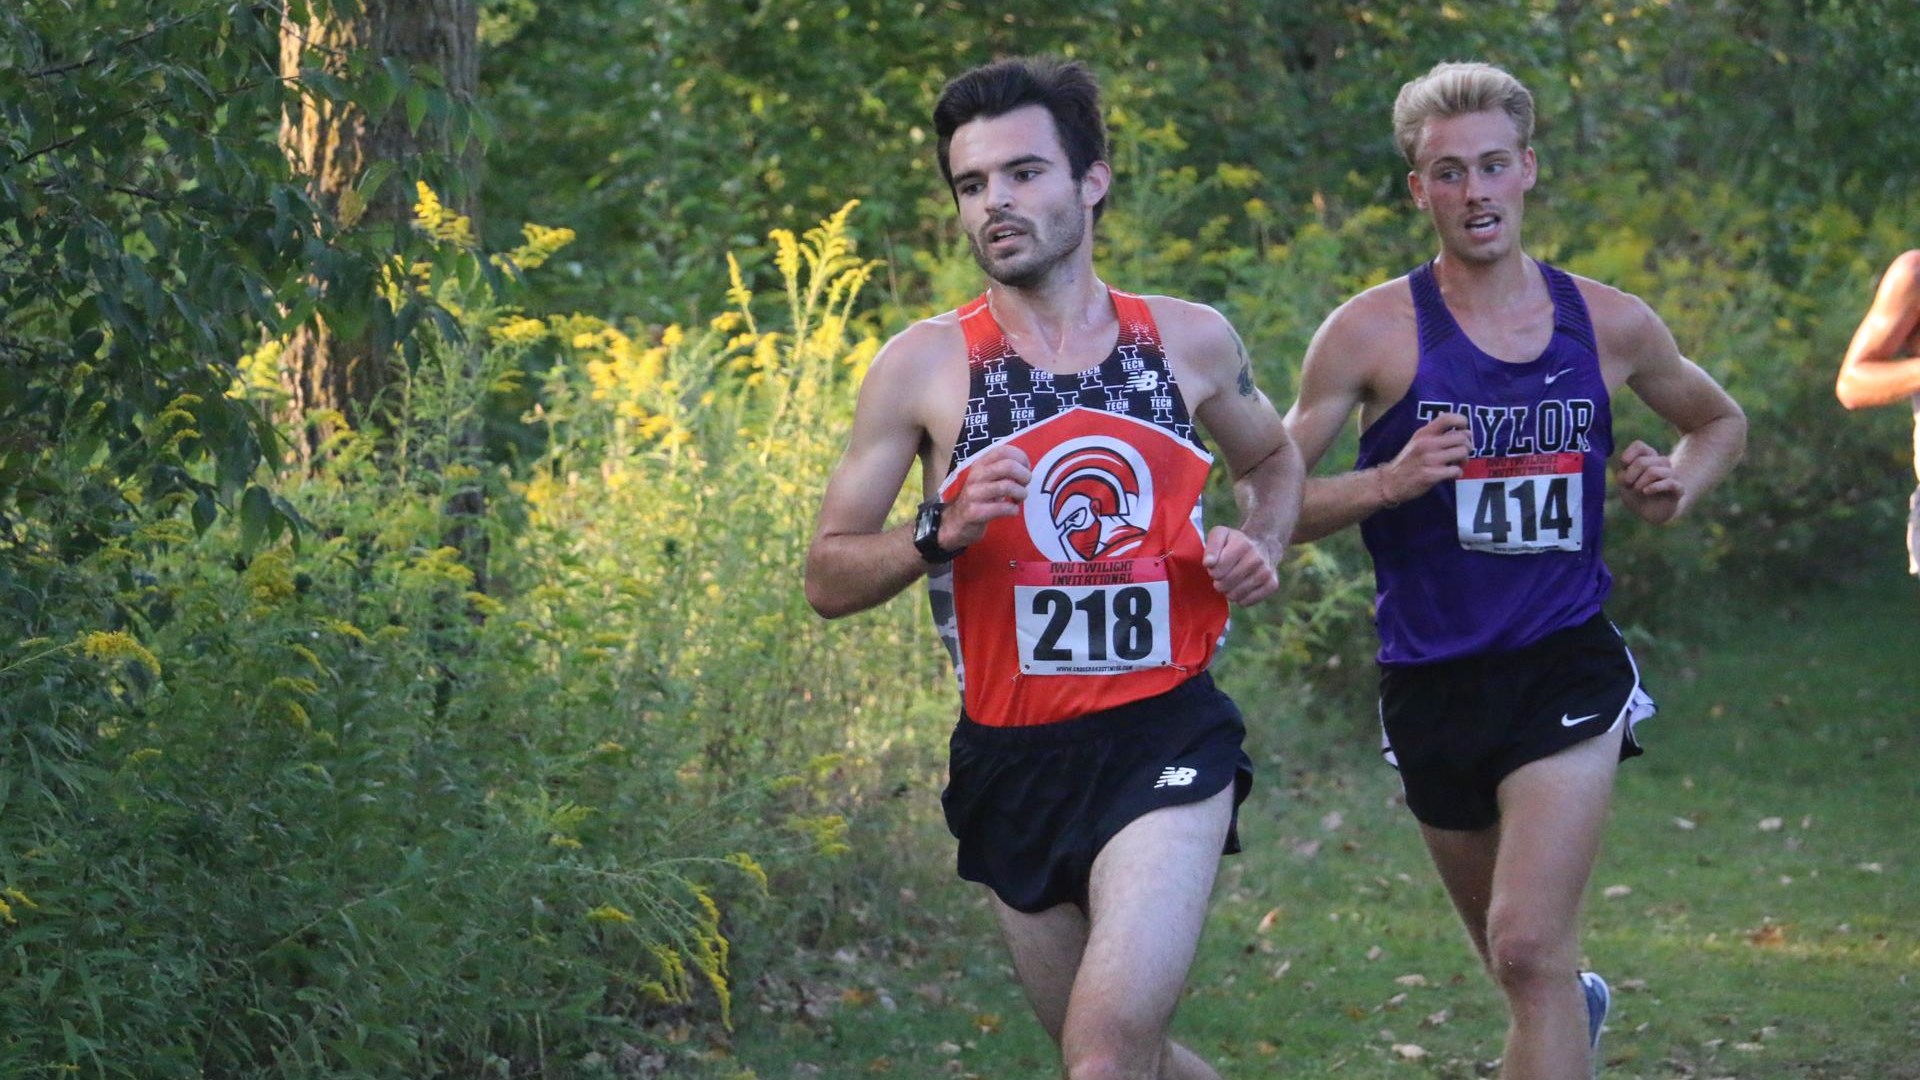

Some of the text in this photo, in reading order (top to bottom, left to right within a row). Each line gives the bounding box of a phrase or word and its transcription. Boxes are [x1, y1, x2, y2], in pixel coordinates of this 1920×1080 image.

[1121, 359, 1145, 370] TECH
[984, 373, 1008, 383] TECH
[1030, 371, 1054, 380] TECH
[1105, 400, 1129, 411] TECH
[1150, 398, 1172, 408] TECH
[965, 413, 988, 425] TECH
[1010, 409, 1035, 420] TECH
[1473, 478, 1572, 543] 414
[1050, 560, 1135, 573] IWU TWILIGHT
[1052, 573, 1134, 586] INVITATIONAL
[1032, 586, 1153, 661] 218
